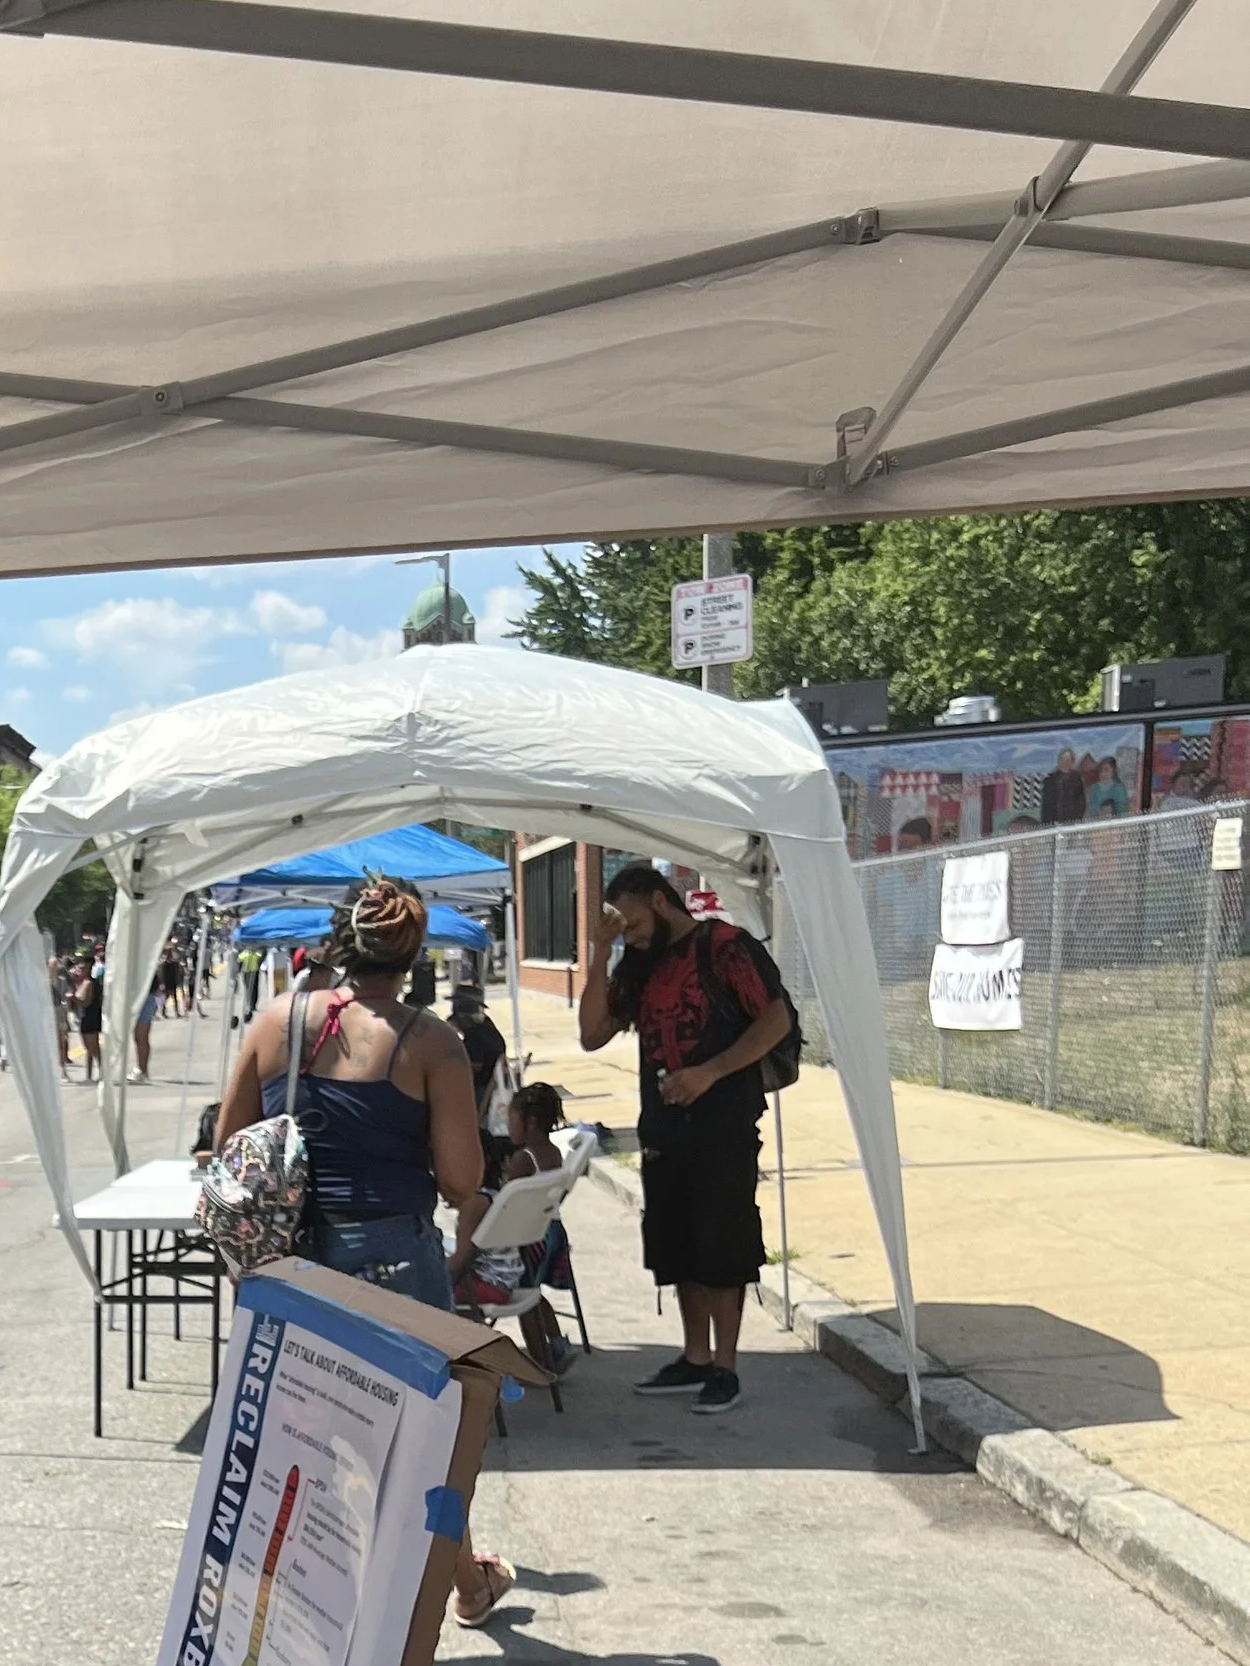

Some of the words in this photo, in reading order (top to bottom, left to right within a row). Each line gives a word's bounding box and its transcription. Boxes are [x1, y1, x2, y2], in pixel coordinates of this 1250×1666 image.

[283, 1340, 299, 1357] LET'S
[300, 1346, 315, 1364] TALK
[315, 1354, 335, 1373] ABOUT
[336, 1364, 370, 1391] AFFORDABLE
[370, 1381, 398, 1406] HOUSING
[212, 1343, 274, 1547] RECLAIM
